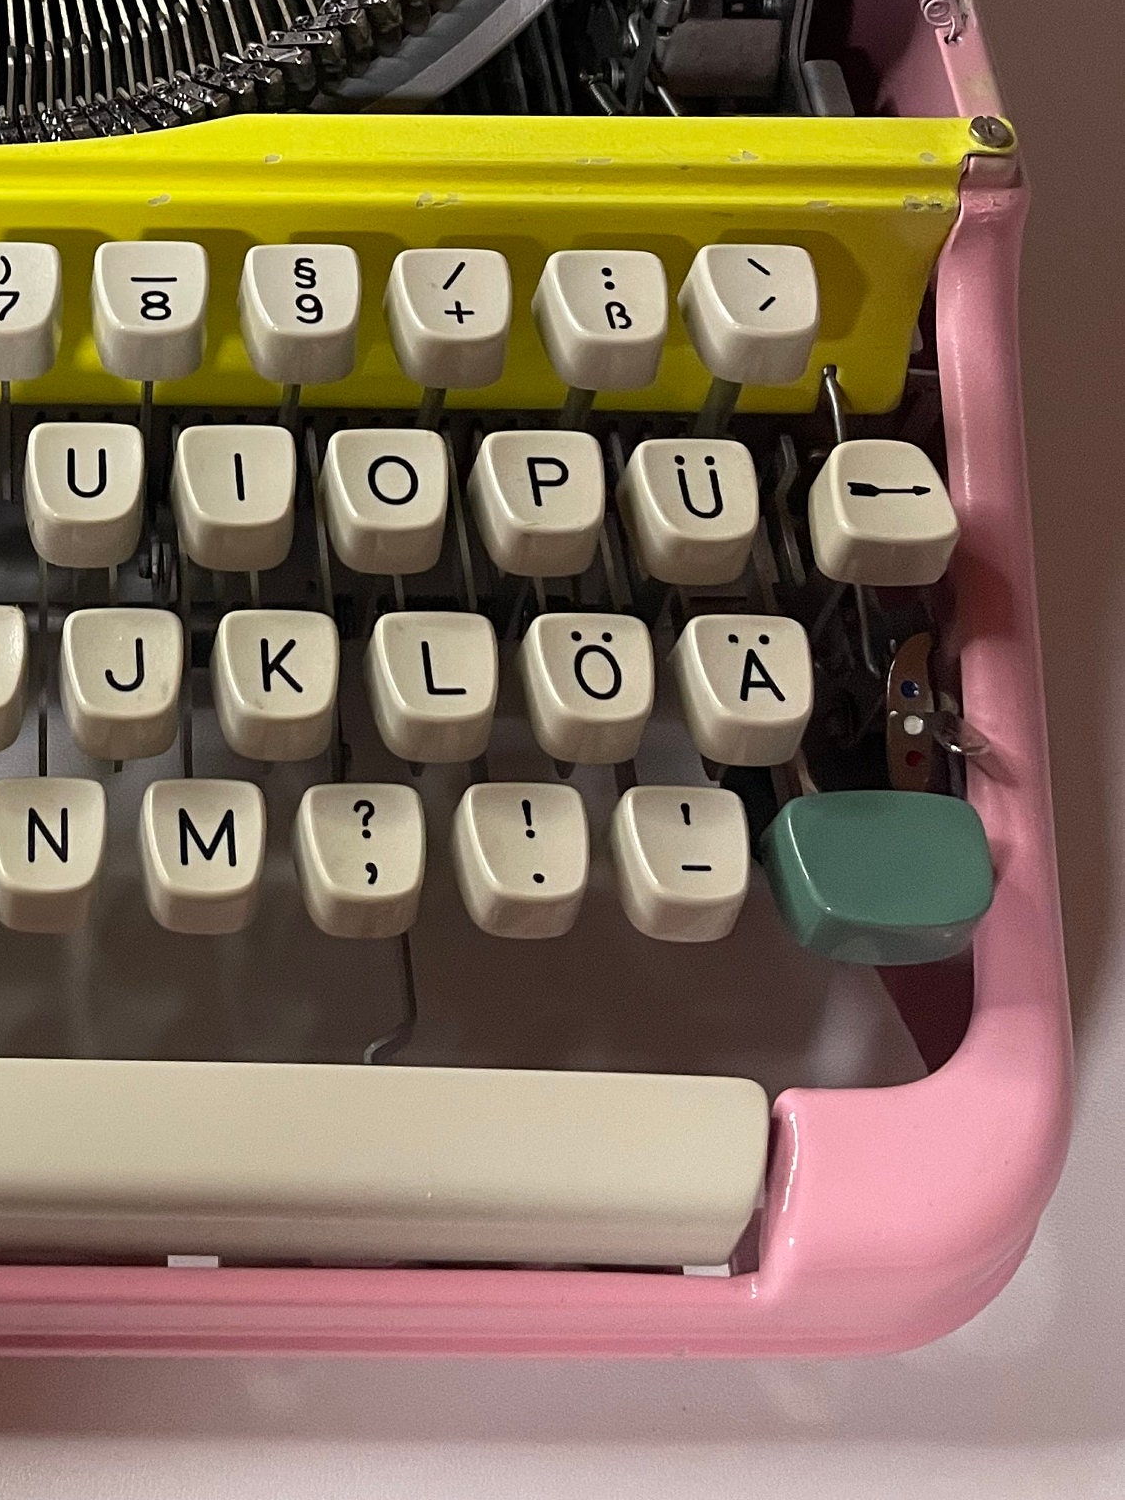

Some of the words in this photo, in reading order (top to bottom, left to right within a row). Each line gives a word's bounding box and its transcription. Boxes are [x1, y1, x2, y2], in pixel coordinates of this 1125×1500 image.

[139, 290, 172, 321] 8
[294, 293, 324, 325] 9
[444, 301, 475, 324] +
[66, 447, 107, 499] U
[233, 452, 245, 502] I
[367, 455, 419, 506] O
[526, 456, 569, 508] P
[674, 454, 724, 519] Ü
[104, 637, 144, 693] J
[260, 637, 304, 693] K
[420, 640, 467, 696] L
[570, 630, 622, 700] Ö
[727, 633, 787, 702] Ä
[27, 807, 69, 864] N
[178, 807, 237, 867] M
[352, 799, 375, 839] ?
[521, 799, 536, 839] !
